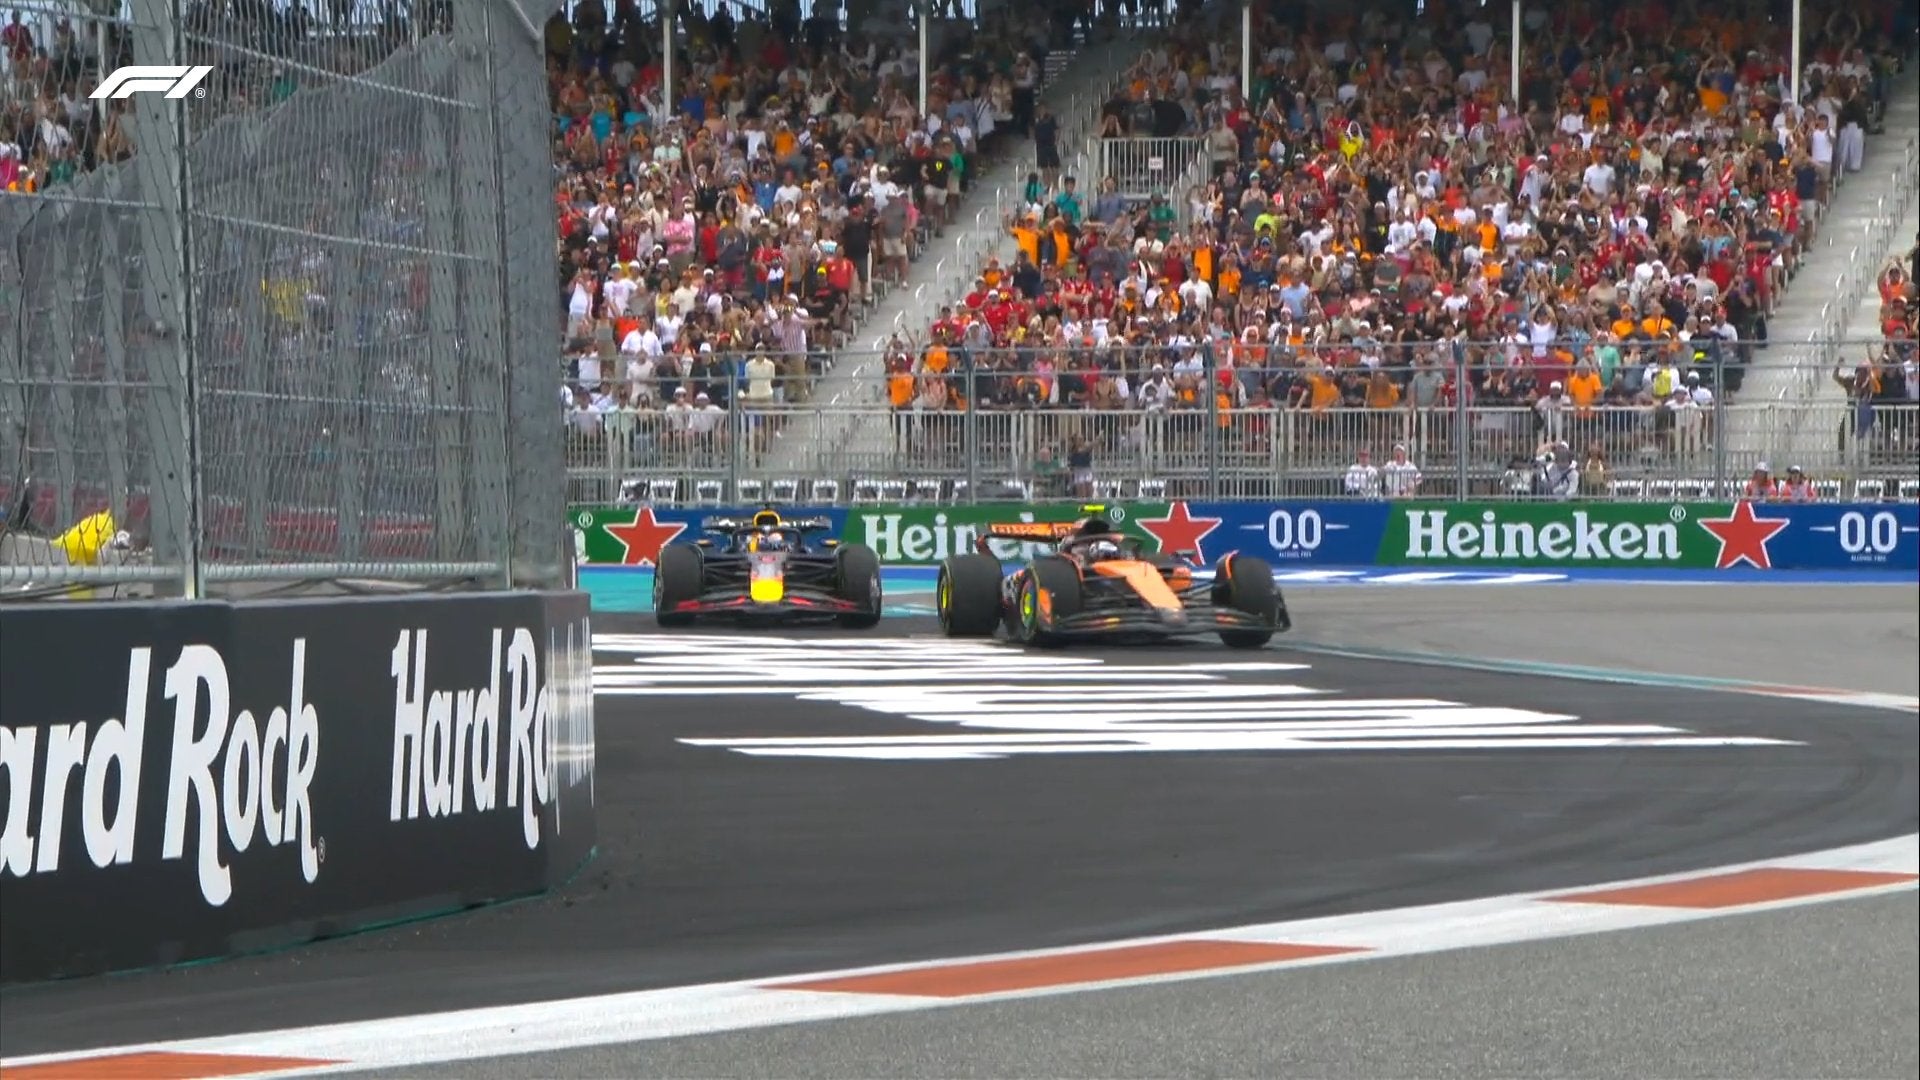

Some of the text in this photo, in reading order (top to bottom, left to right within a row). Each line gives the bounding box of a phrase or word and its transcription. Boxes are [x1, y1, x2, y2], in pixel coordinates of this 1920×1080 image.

[1268, 509, 1322, 550] 0.0
[1405, 510, 1682, 560] Heineken
[1839, 511, 1898, 553] 0.0
[391, 617, 594, 849] Hard Ro
[0, 638, 319, 907] ard Rock
